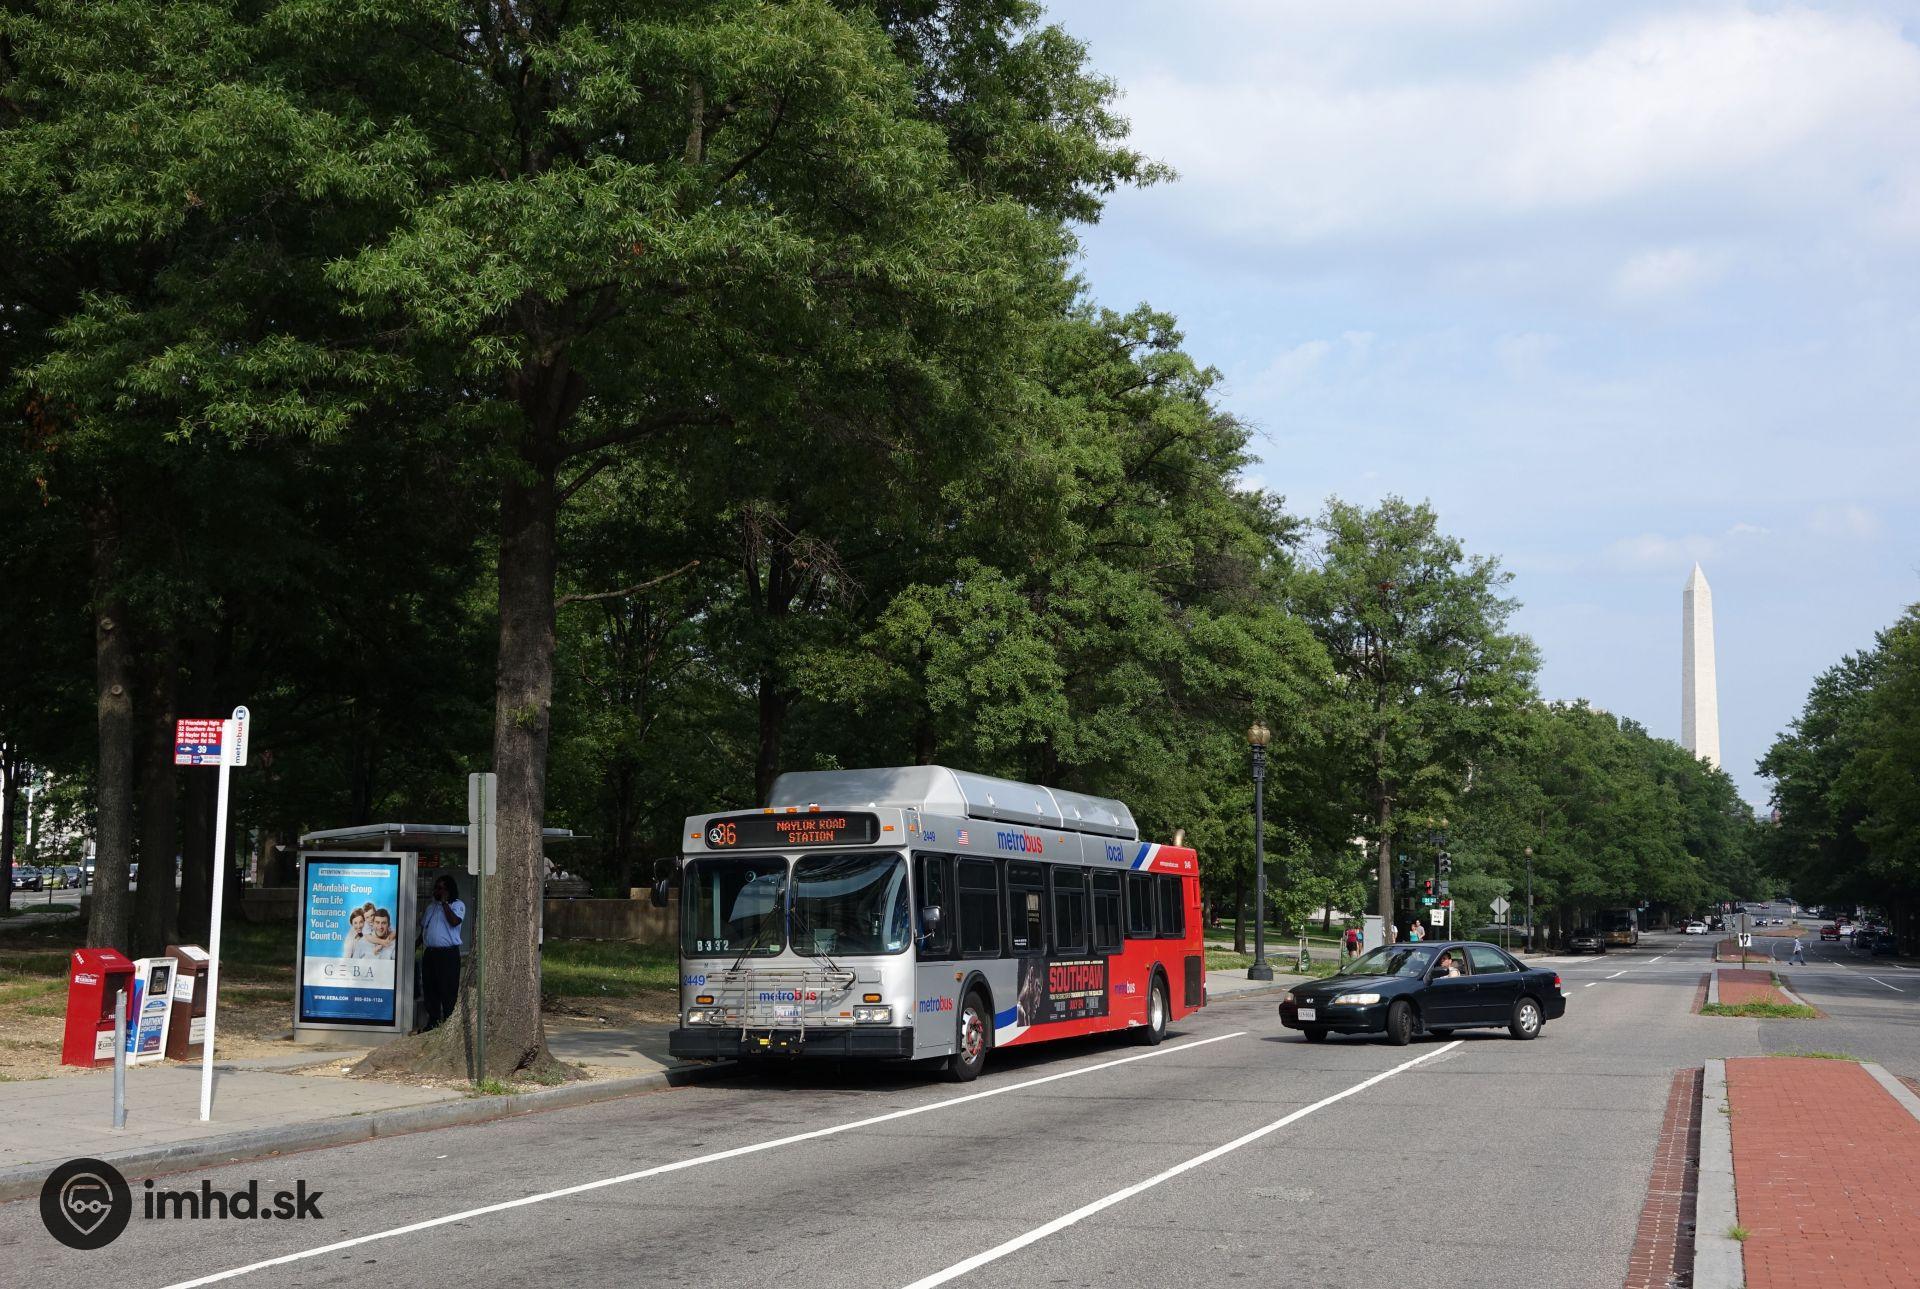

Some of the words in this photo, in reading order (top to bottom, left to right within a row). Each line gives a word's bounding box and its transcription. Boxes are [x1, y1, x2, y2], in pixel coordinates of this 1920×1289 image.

[235, 721, 243, 764] metrobus
[197, 745, 207, 753] 39
[776, 820, 816, 831] NAYLOR
[819, 818, 846, 829] ROAD
[717, 823, 736, 845] 36
[789, 831, 834, 843] STATION
[923, 830, 936, 842] 2449
[997, 830, 1043, 854] metrobus
[1105, 841, 1124, 862] local
[312, 883, 349, 892] Affordable
[350, 883, 373, 895] Group
[312, 894, 329, 904] Term
[331, 895, 344, 905] Life
[311, 907, 346, 917] Insurance
[310, 919, 324, 928] You
[325, 919, 339, 929] Can
[310, 930, 330, 940] Count
[683, 974, 706, 986] 2449
[1049, 965, 1104, 993] SOUTHPAW
[1114, 980, 1136, 994] metrobus
[919, 996, 953, 1014] metrobus
